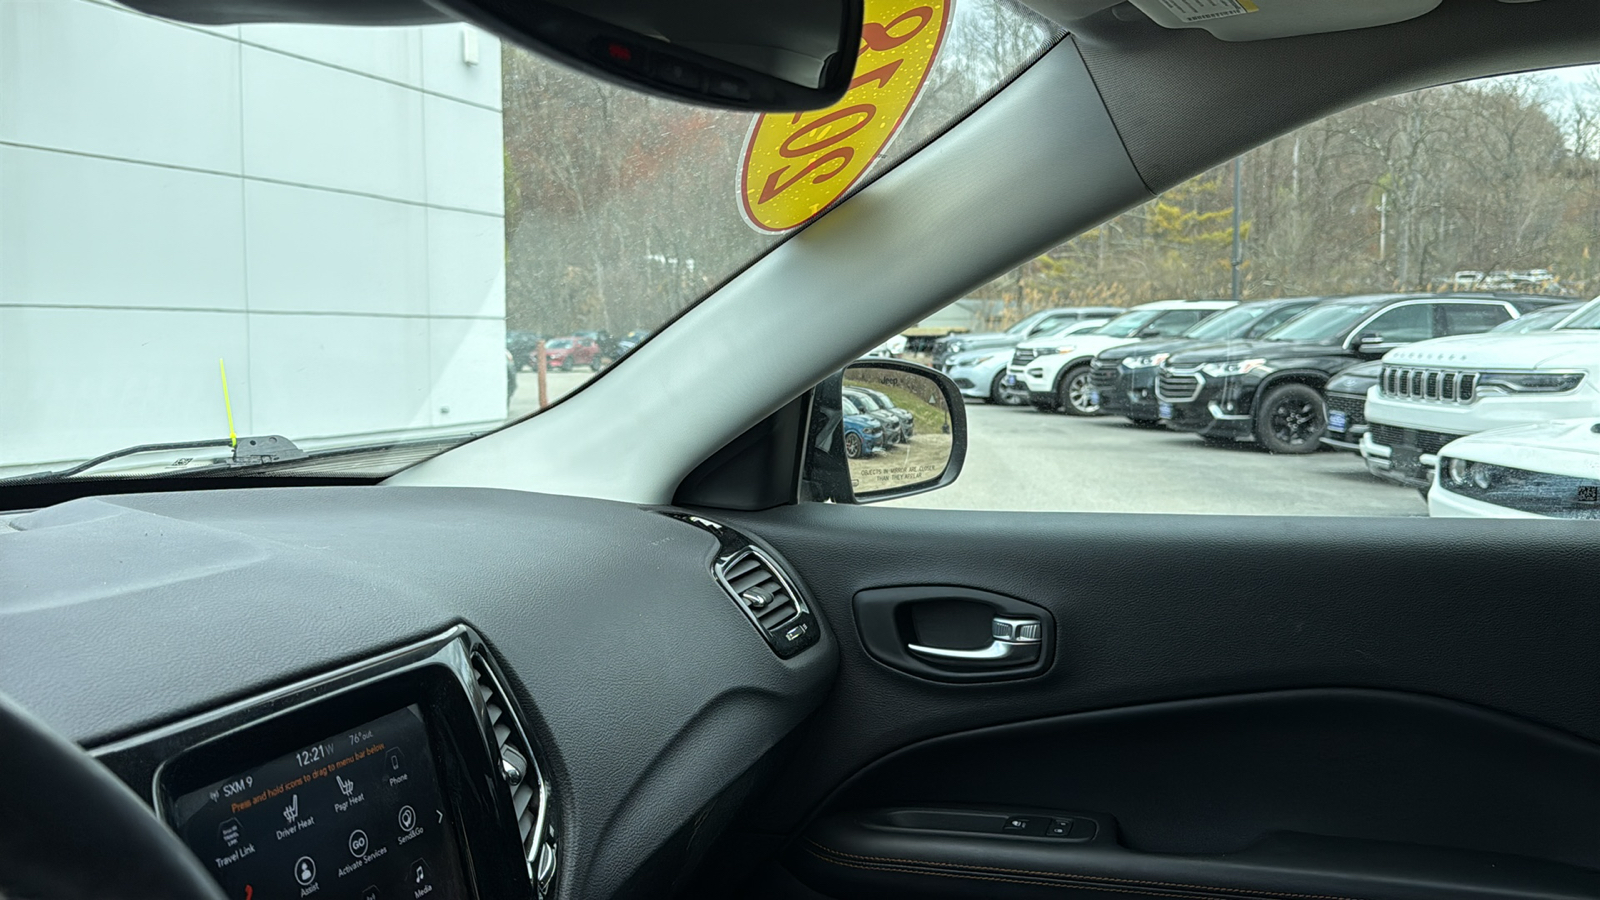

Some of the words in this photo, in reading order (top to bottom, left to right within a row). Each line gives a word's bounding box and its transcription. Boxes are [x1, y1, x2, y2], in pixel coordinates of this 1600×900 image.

[296, 744, 325, 767] 12:21
[223, 778, 245, 797] SXM
[246, 776, 253, 788] 9
[230, 800, 252, 813] Press
[252, 791, 267, 804] and
[267, 784, 284, 798] hold
[284, 778, 303, 791] icons
[303, 774, 311, 783] to
[312, 768, 328, 779] drag
[328, 763, 336, 772] to
[336, 756, 355, 769] menu
[354, 751, 366, 761] bar
[366, 743, 385, 756] below
[389, 773, 408, 787] Phone
[334, 801, 348, 813] Psgr
[348, 792, 365, 806] Heat
[276, 825, 297, 840] Driver
[297, 816, 315, 830] Heat
[397, 827, 424, 845] Send&Go
[352, 837, 365, 850] GO
[215, 850, 239, 868] Travel
[239, 843, 256, 858] Link
[338, 859, 363, 878] Activate
[363, 847, 388, 864] Services
[301, 882, 320, 898] Assist
[414, 884, 433, 899] Media
